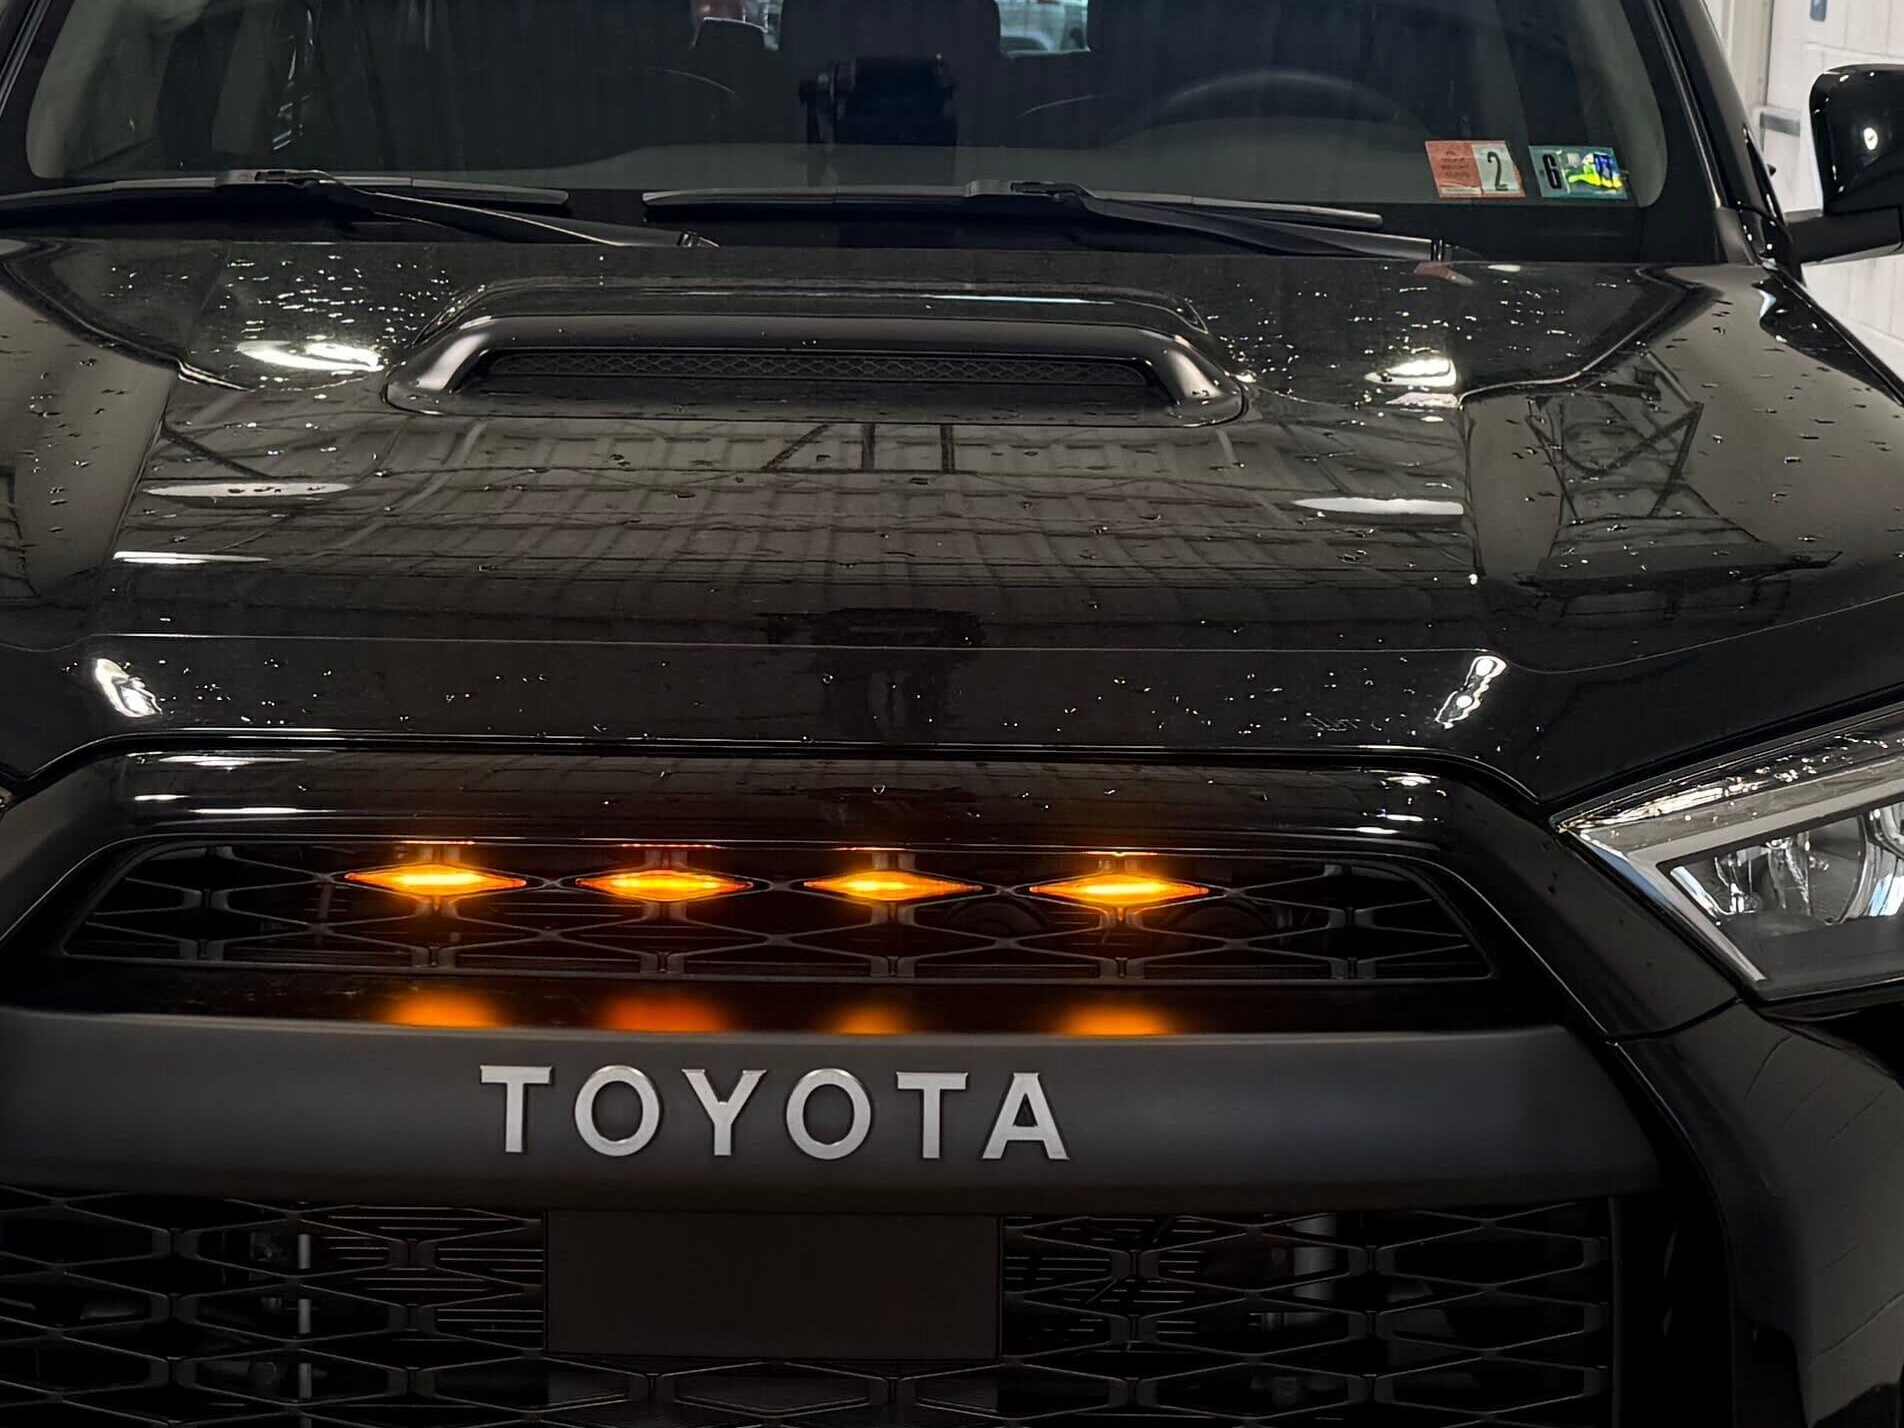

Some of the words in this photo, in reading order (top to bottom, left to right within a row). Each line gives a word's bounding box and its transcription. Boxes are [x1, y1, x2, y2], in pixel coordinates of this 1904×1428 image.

[1487, 151, 1509, 192] 2
[1542, 153, 1562, 190] 6
[480, 1065, 1070, 1160] TOYOTA
